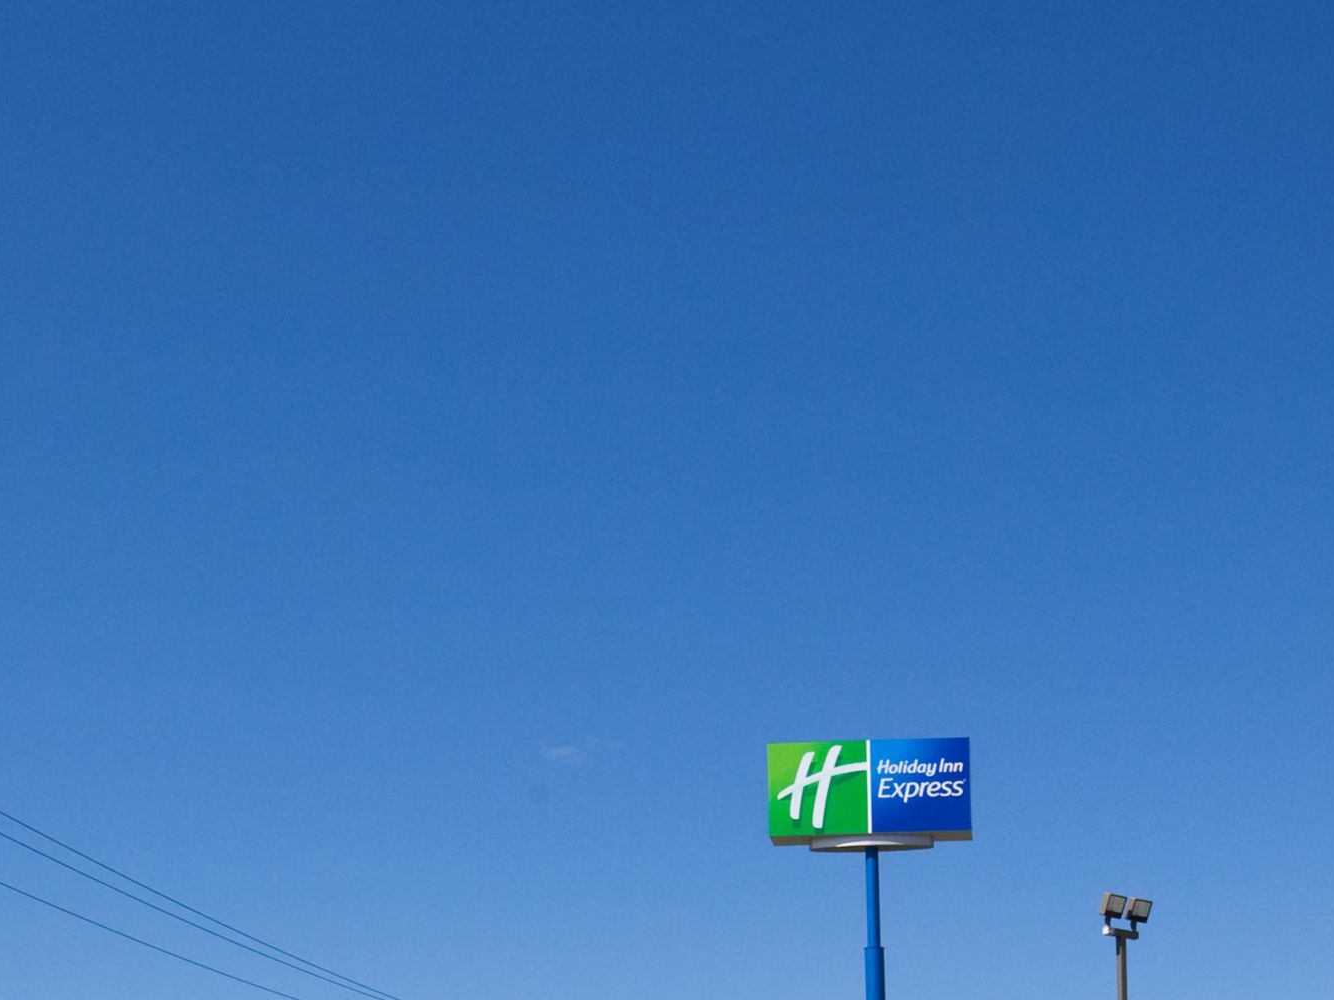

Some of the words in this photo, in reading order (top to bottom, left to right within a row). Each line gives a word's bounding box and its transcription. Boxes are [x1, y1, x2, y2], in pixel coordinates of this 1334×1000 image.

[877, 759, 936, 777] Holiday
[938, 758, 963, 773] Inn
[776, 745, 867, 829] H
[877, 778, 964, 803] Express
